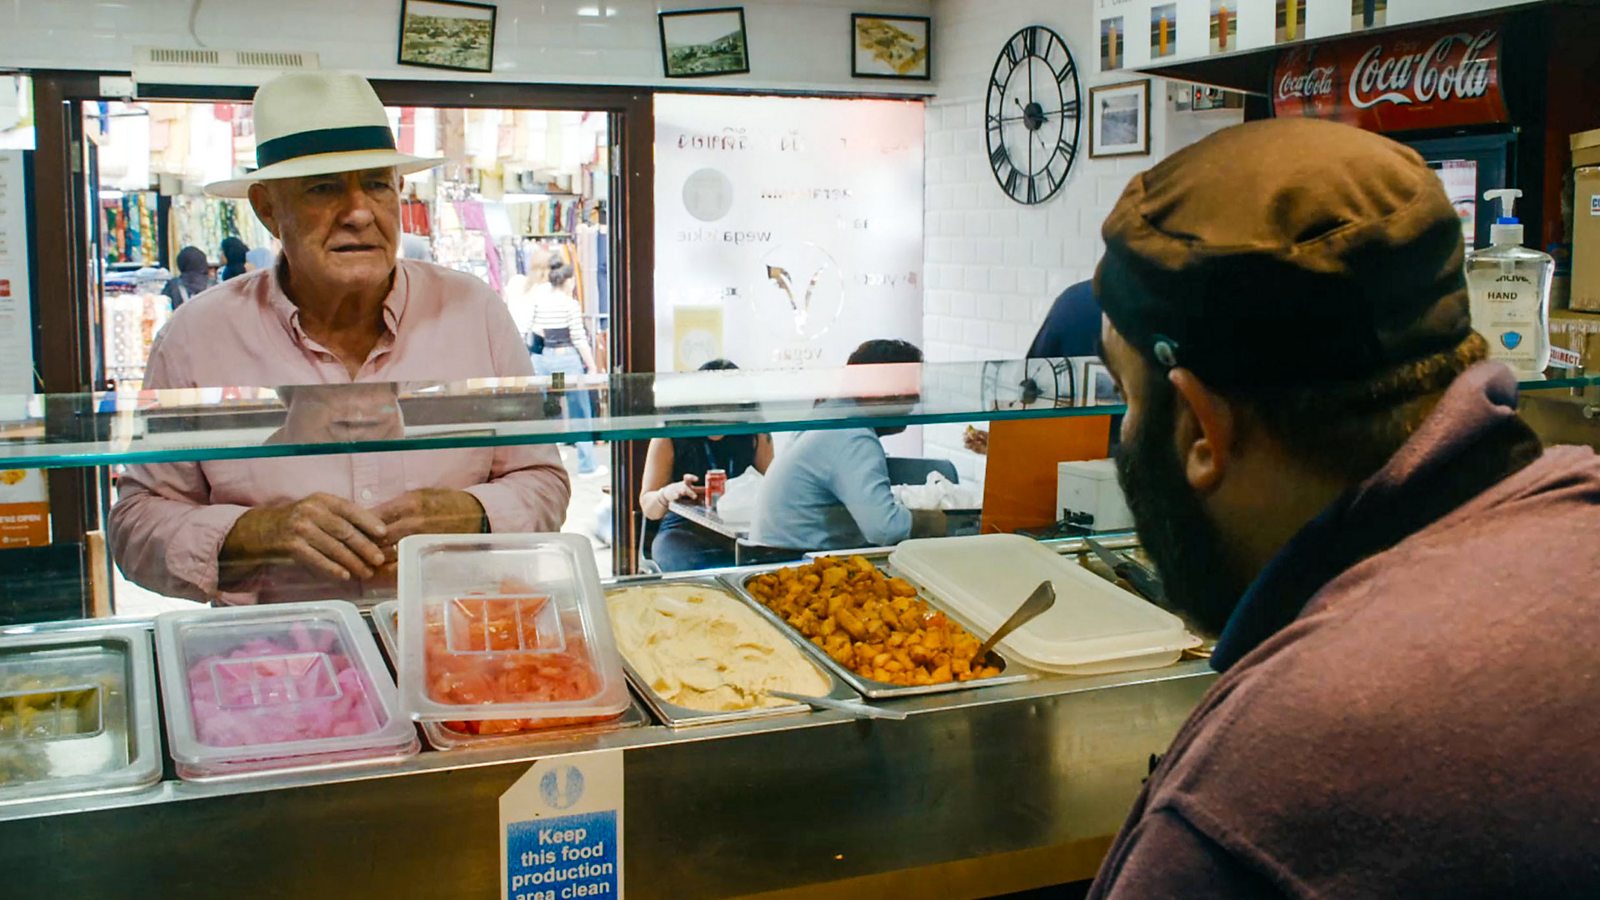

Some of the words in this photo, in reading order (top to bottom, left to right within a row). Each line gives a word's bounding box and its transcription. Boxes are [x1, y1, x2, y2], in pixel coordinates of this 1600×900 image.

[1348, 30, 1497, 109] Coca-Cola
[1279, 65, 1336, 100] Coca-Cola
[1592, 198, 1600, 208] C
[1488, 292, 1518, 300] HAND
[538, 828, 588, 845] Keep
[521, 850, 556, 867] this
[561, 841, 604, 861] food
[512, 862, 613, 891] production
[561, 881, 610, 898] clean
